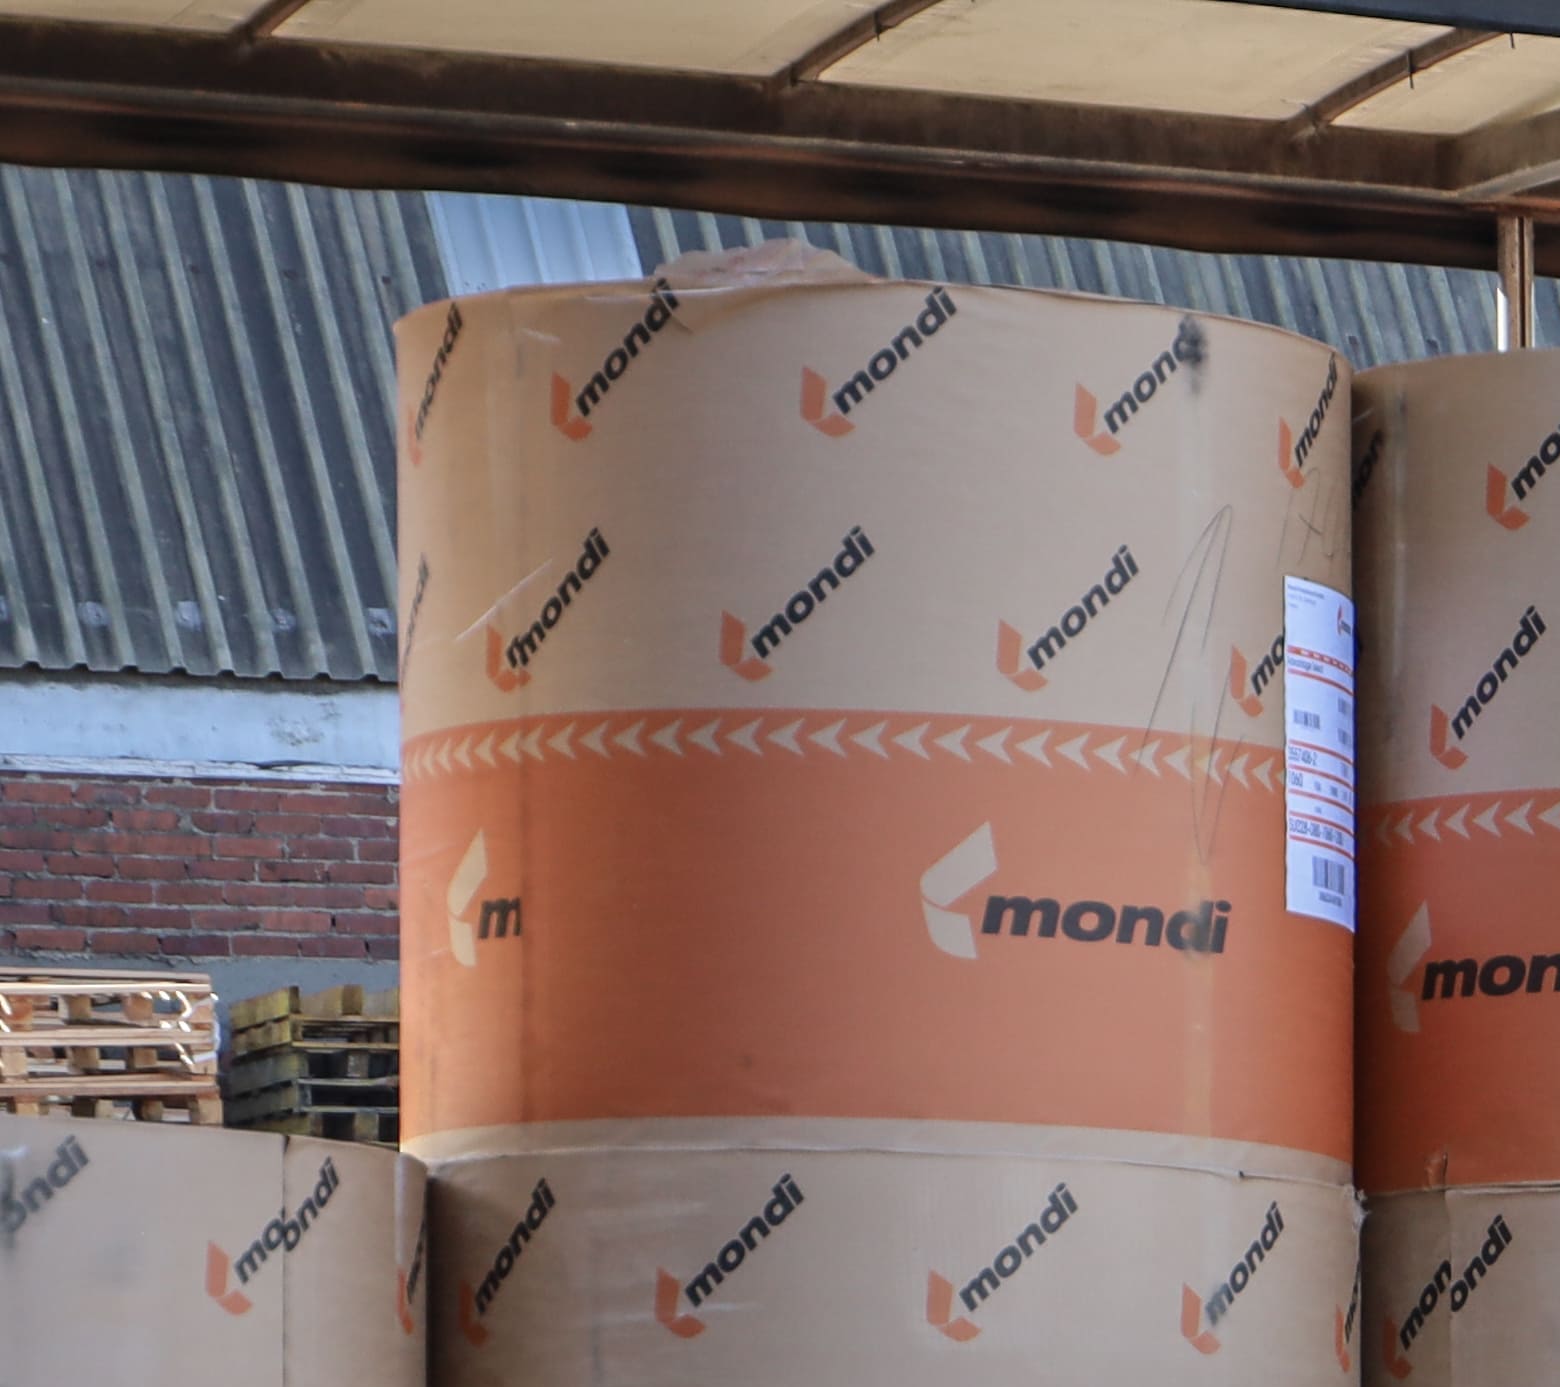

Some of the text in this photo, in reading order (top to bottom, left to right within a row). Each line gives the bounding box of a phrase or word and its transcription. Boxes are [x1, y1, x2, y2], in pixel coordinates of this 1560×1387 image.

[414, 303, 464, 441] mondi
[576, 279, 679, 416] mondi
[831, 283, 957, 416] mondi
[1295, 352, 1337, 467] mondi
[752, 527, 874, 658] mondi
[1028, 546, 1138, 670] mondi
[1452, 606, 1546, 739] mondi
[981, 896, 1231, 953] mondi
[475, 1177, 556, 1315] mondi
[685, 1174, 803, 1307] mondi
[960, 1183, 1077, 1312] mondi
[1207, 1202, 1284, 1324] mondi
